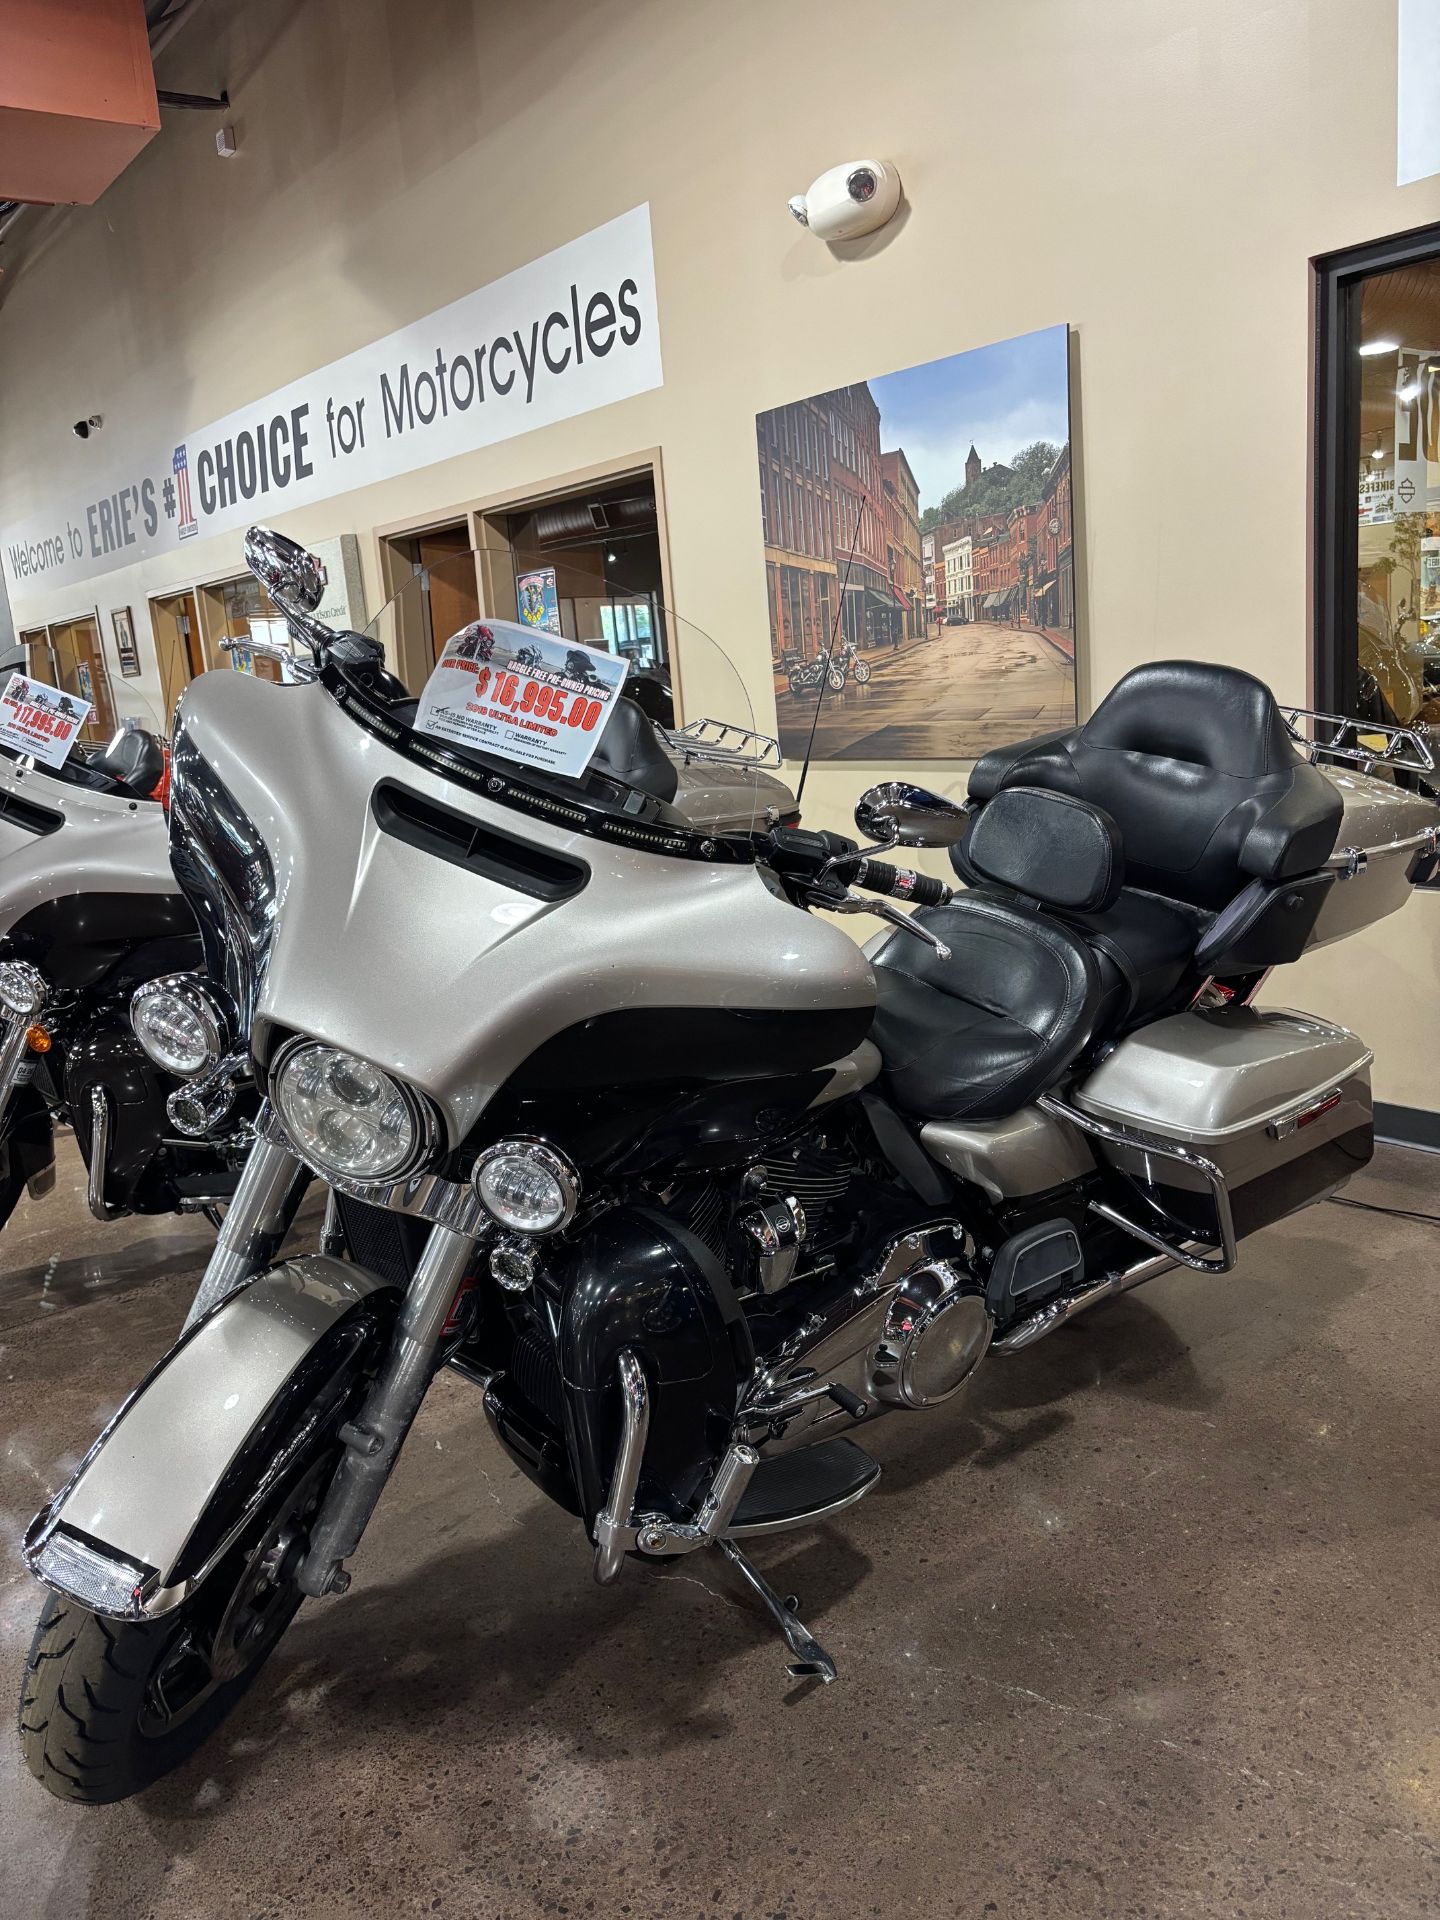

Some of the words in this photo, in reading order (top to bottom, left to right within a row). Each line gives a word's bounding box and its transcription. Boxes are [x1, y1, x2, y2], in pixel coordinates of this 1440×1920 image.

[9, 531, 64, 580] Welcome
[67, 522, 84, 558] to
[86, 478, 159, 557] ERIE'S
[197, 403, 314, 515] CHOICE
[326, 397, 367, 459] for
[380, 278, 642, 436] Motorcycles
[507, 661, 532, 676] HAGGLE
[532, 668, 547, 681] FREE
[547, 672, 584, 693] PRE-OWNED
[583, 685, 611, 701] PRICING
[465, 716, 498, 730] WARRANTY
[489, 709, 519, 726] ULTRA
[519, 718, 558, 737] LIMITED
[515, 732, 547, 746] WARRANTY
